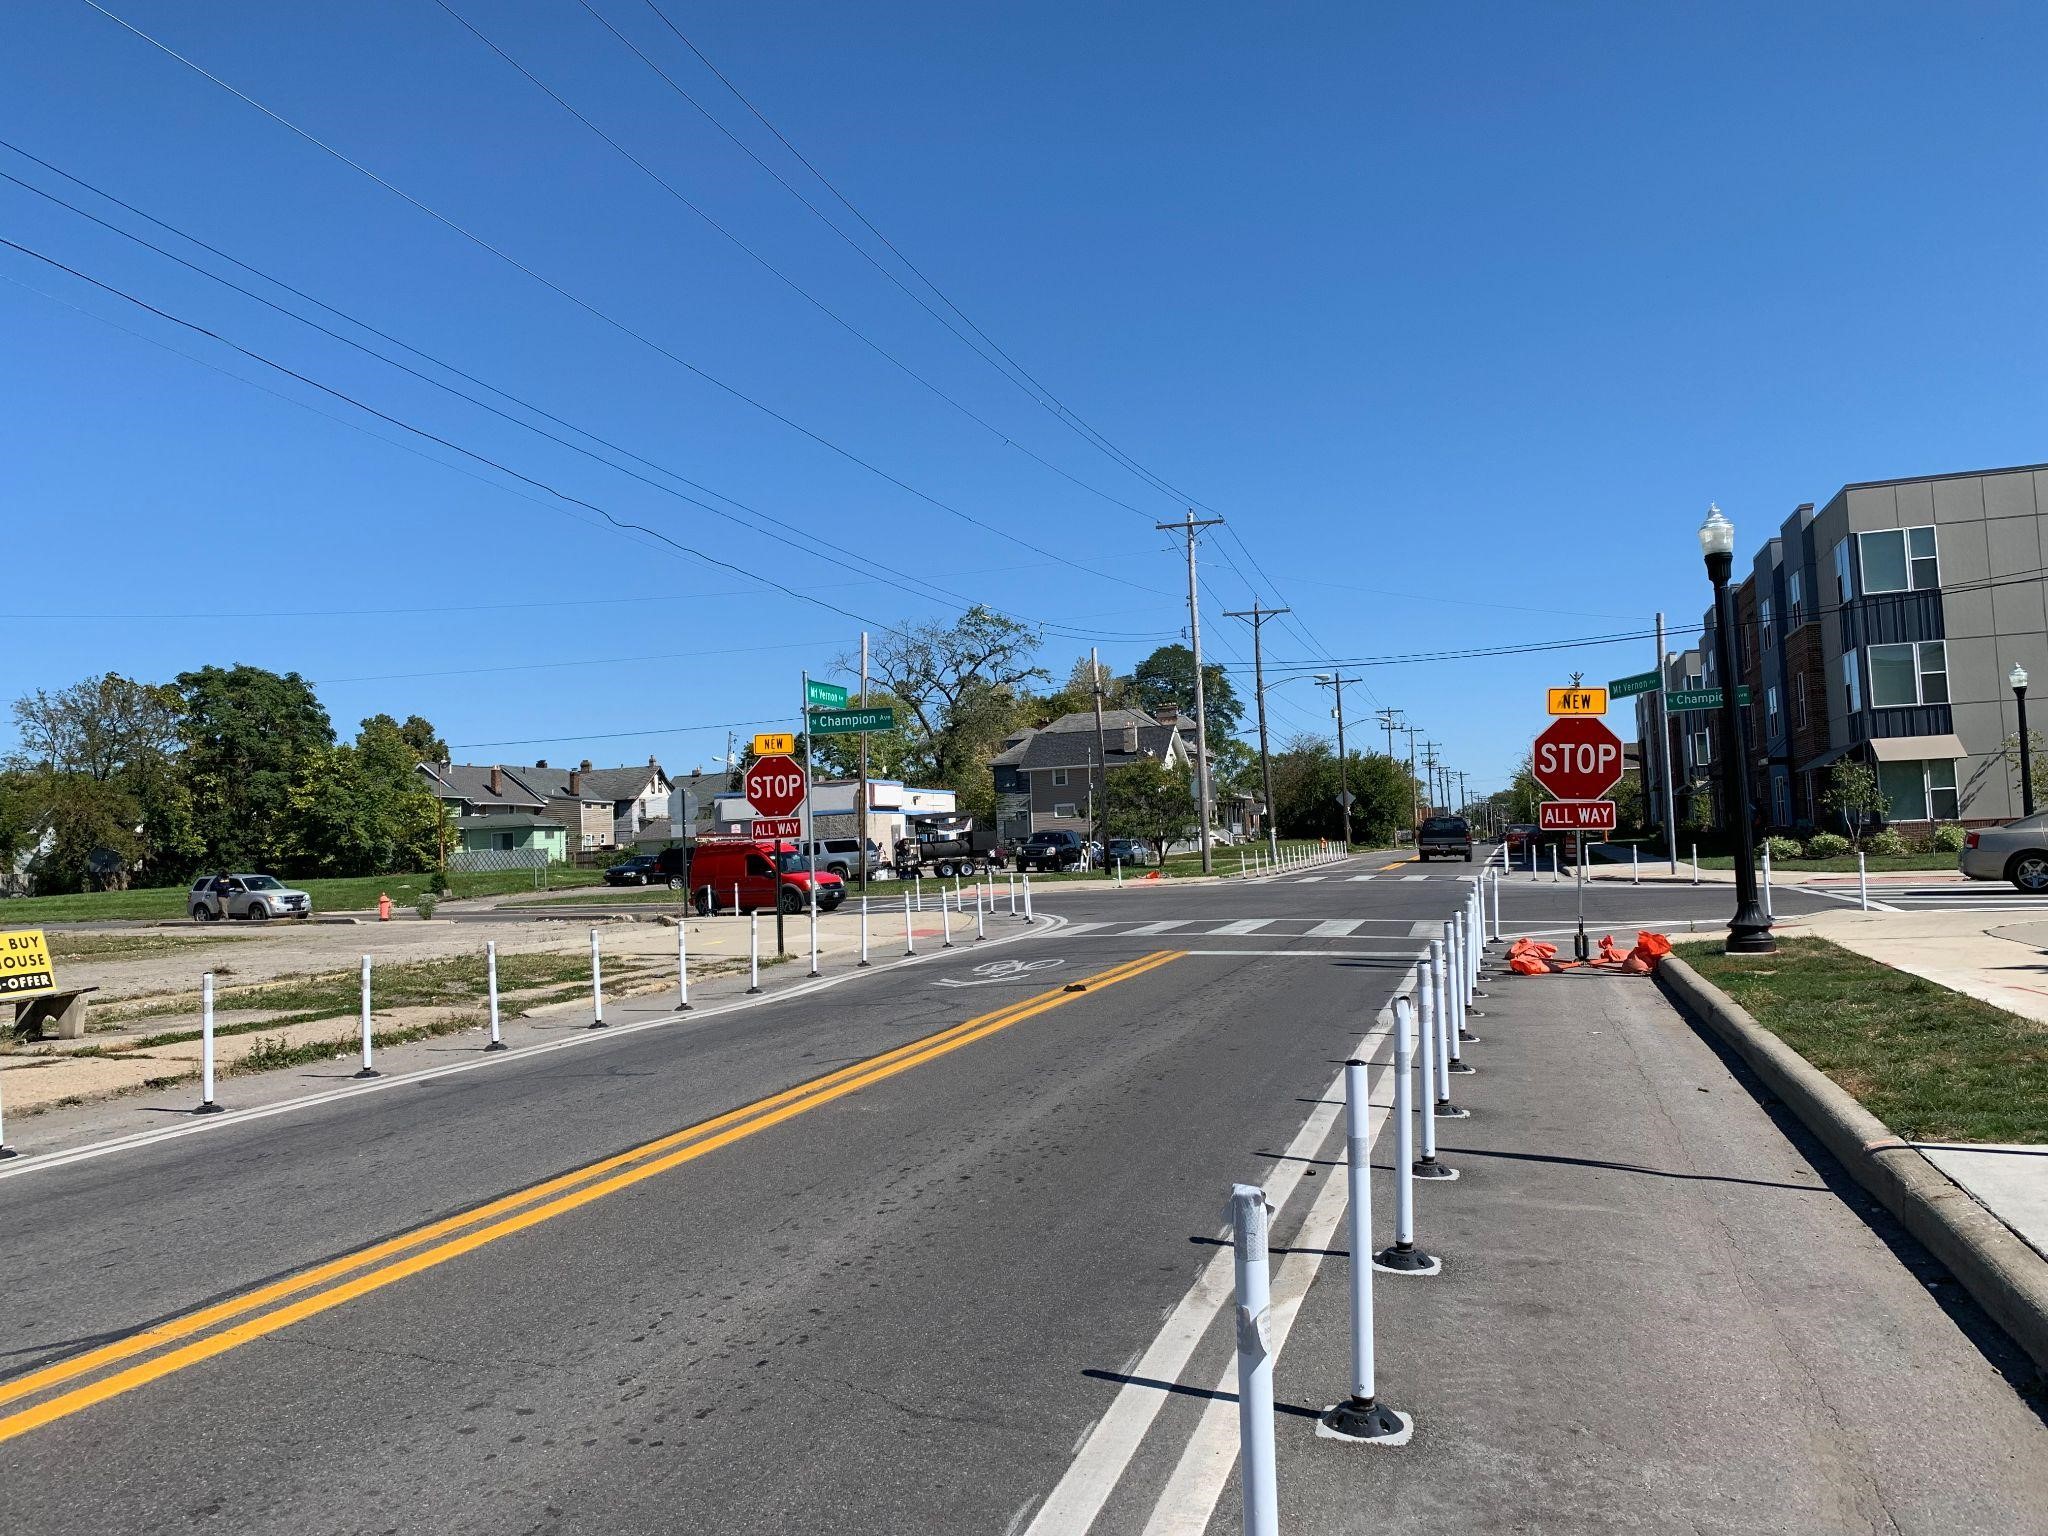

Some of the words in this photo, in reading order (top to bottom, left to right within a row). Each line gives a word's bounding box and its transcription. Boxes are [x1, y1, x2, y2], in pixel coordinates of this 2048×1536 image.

[810, 687, 818, 699] Mt
[819, 689, 838, 702] Vernon
[1612, 684, 1621, 695] Mt
[1623, 680, 1648, 692] Vernon
[1563, 694, 1591, 710] NEW
[820, 713, 876, 727] Champion
[764, 738, 783, 750] NEW
[1539, 743, 1617, 774] STOP
[750, 774, 801, 799] STOP
[1544, 808, 1574, 824] ALL
[1578, 807, 1611, 824] WAY
[755, 824, 775, 837] ALL
[777, 822, 799, 835] WAY
[8, 936, 38, 950] BUY
[0, 953, 45, 970] OUSE
